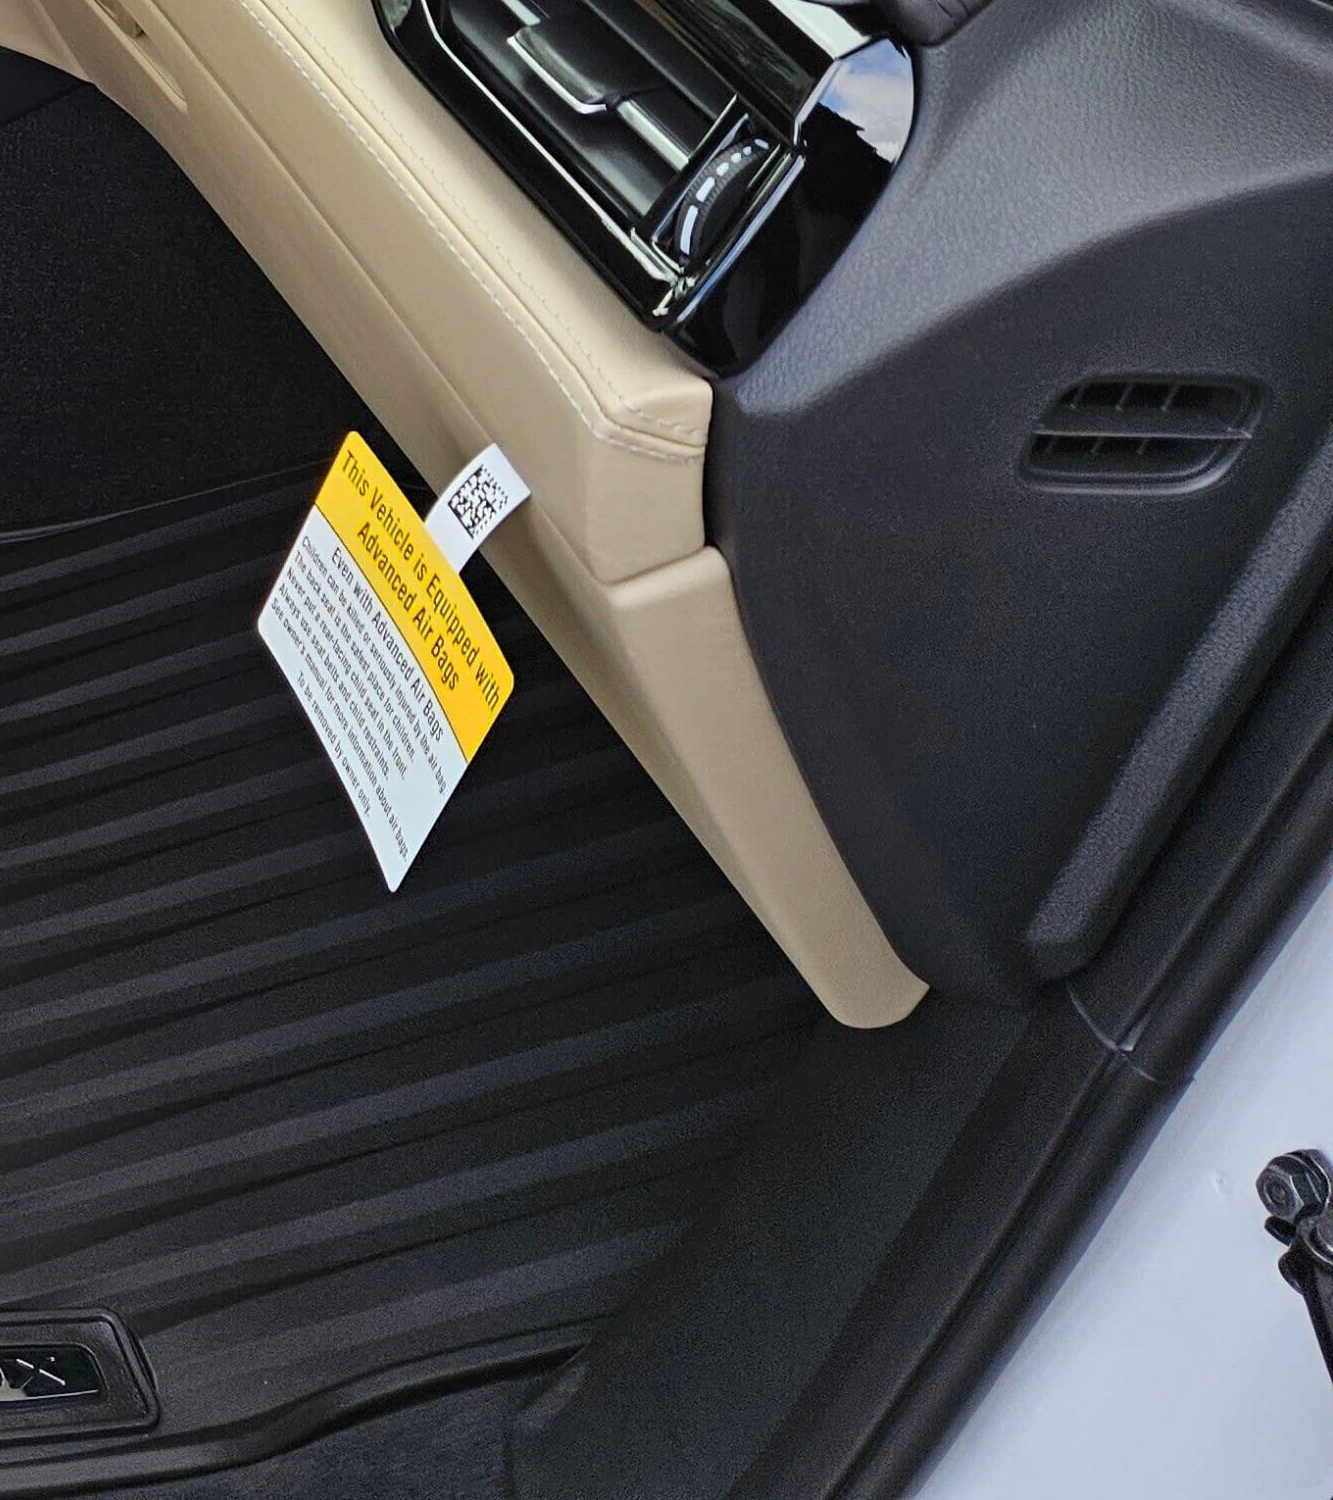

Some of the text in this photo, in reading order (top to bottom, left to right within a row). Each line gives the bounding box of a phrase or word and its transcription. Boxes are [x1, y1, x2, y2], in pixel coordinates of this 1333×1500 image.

[277, 581, 301, 620] Always
[299, 615, 312, 638] use
[309, 632, 325, 660] seat
[323, 652, 339, 684] belts
[337, 678, 351, 703] and
[348, 698, 365, 728] child
[293, 548, 307, 574] The
[305, 568, 322, 596] back
[319, 592, 336, 618] seat
[339, 621, 351, 644] the
[349, 639, 370, 674] safest
[366, 668, 385, 702] place
[383, 695, 395, 716] for
[301, 534, 328, 578] Children
[325, 574, 339, 595] can
[345, 601, 365, 634] killed
[369, 640, 397, 691] seriously
[393, 683, 417, 725] injured
[419, 732, 431, 756] the
[427, 750, 439, 772] air
[331, 545, 444, 744] Even with Advanced Air Bags
[341, 448, 501, 712] This Vehicle is Equipped with
[356, 518, 460, 693] Advanced Air Bags
[271, 596, 284, 620] See
[303, 650, 327, 691] manual
[323, 685, 335, 706] for
[331, 700, 349, 732] more
[346, 724, 378, 788] information
[374, 782, 392, 818] about
[387, 812, 398, 832] air
[303, 594, 317, 615] put
[319, 618, 351, 676] rear-facing
[349, 670, 367, 699] child
[363, 694, 379, 722] seat
[381, 728, 393, 751] the
[311, 698, 337, 746] removed
[341, 754, 360, 791] owner
